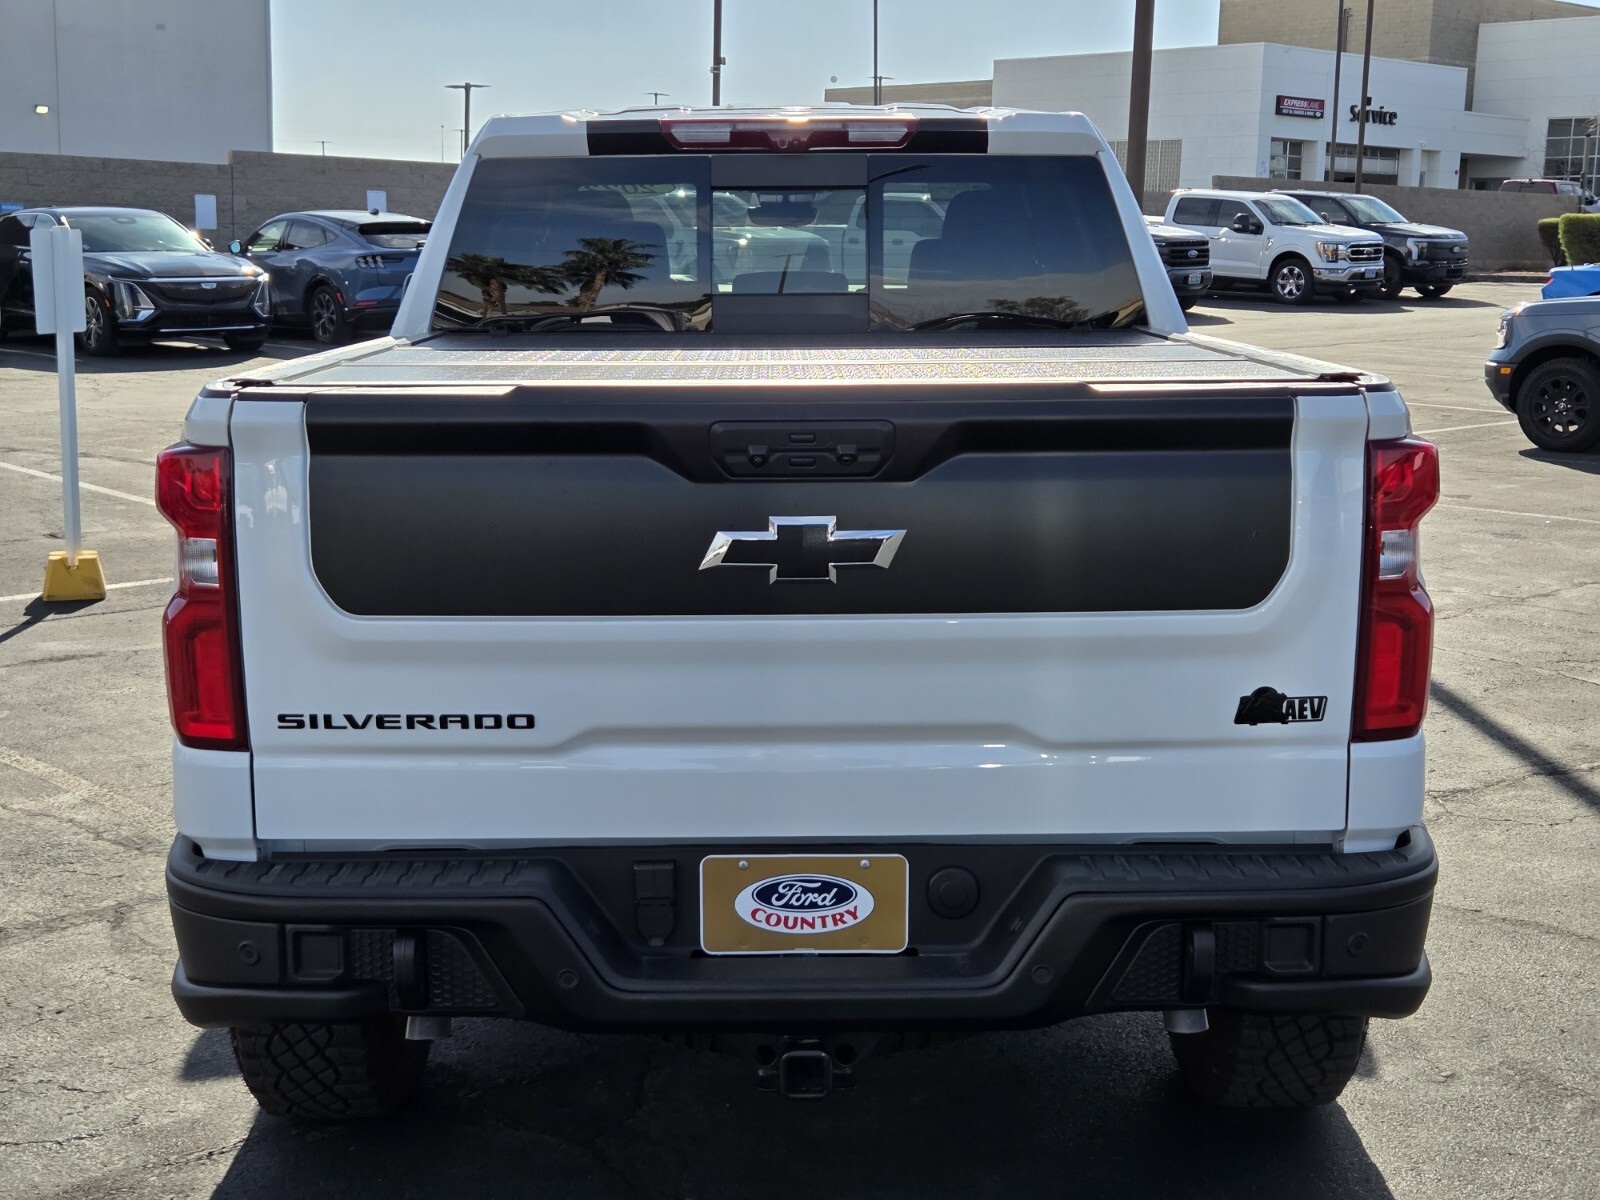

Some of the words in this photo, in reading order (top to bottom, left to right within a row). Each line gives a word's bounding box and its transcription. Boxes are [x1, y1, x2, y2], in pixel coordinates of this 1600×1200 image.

[1285, 698, 1324, 720] AEV
[277, 714, 535, 730] SILVERADO
[771, 881, 838, 906] Ford
[750, 905, 860, 930] COUNTRY
